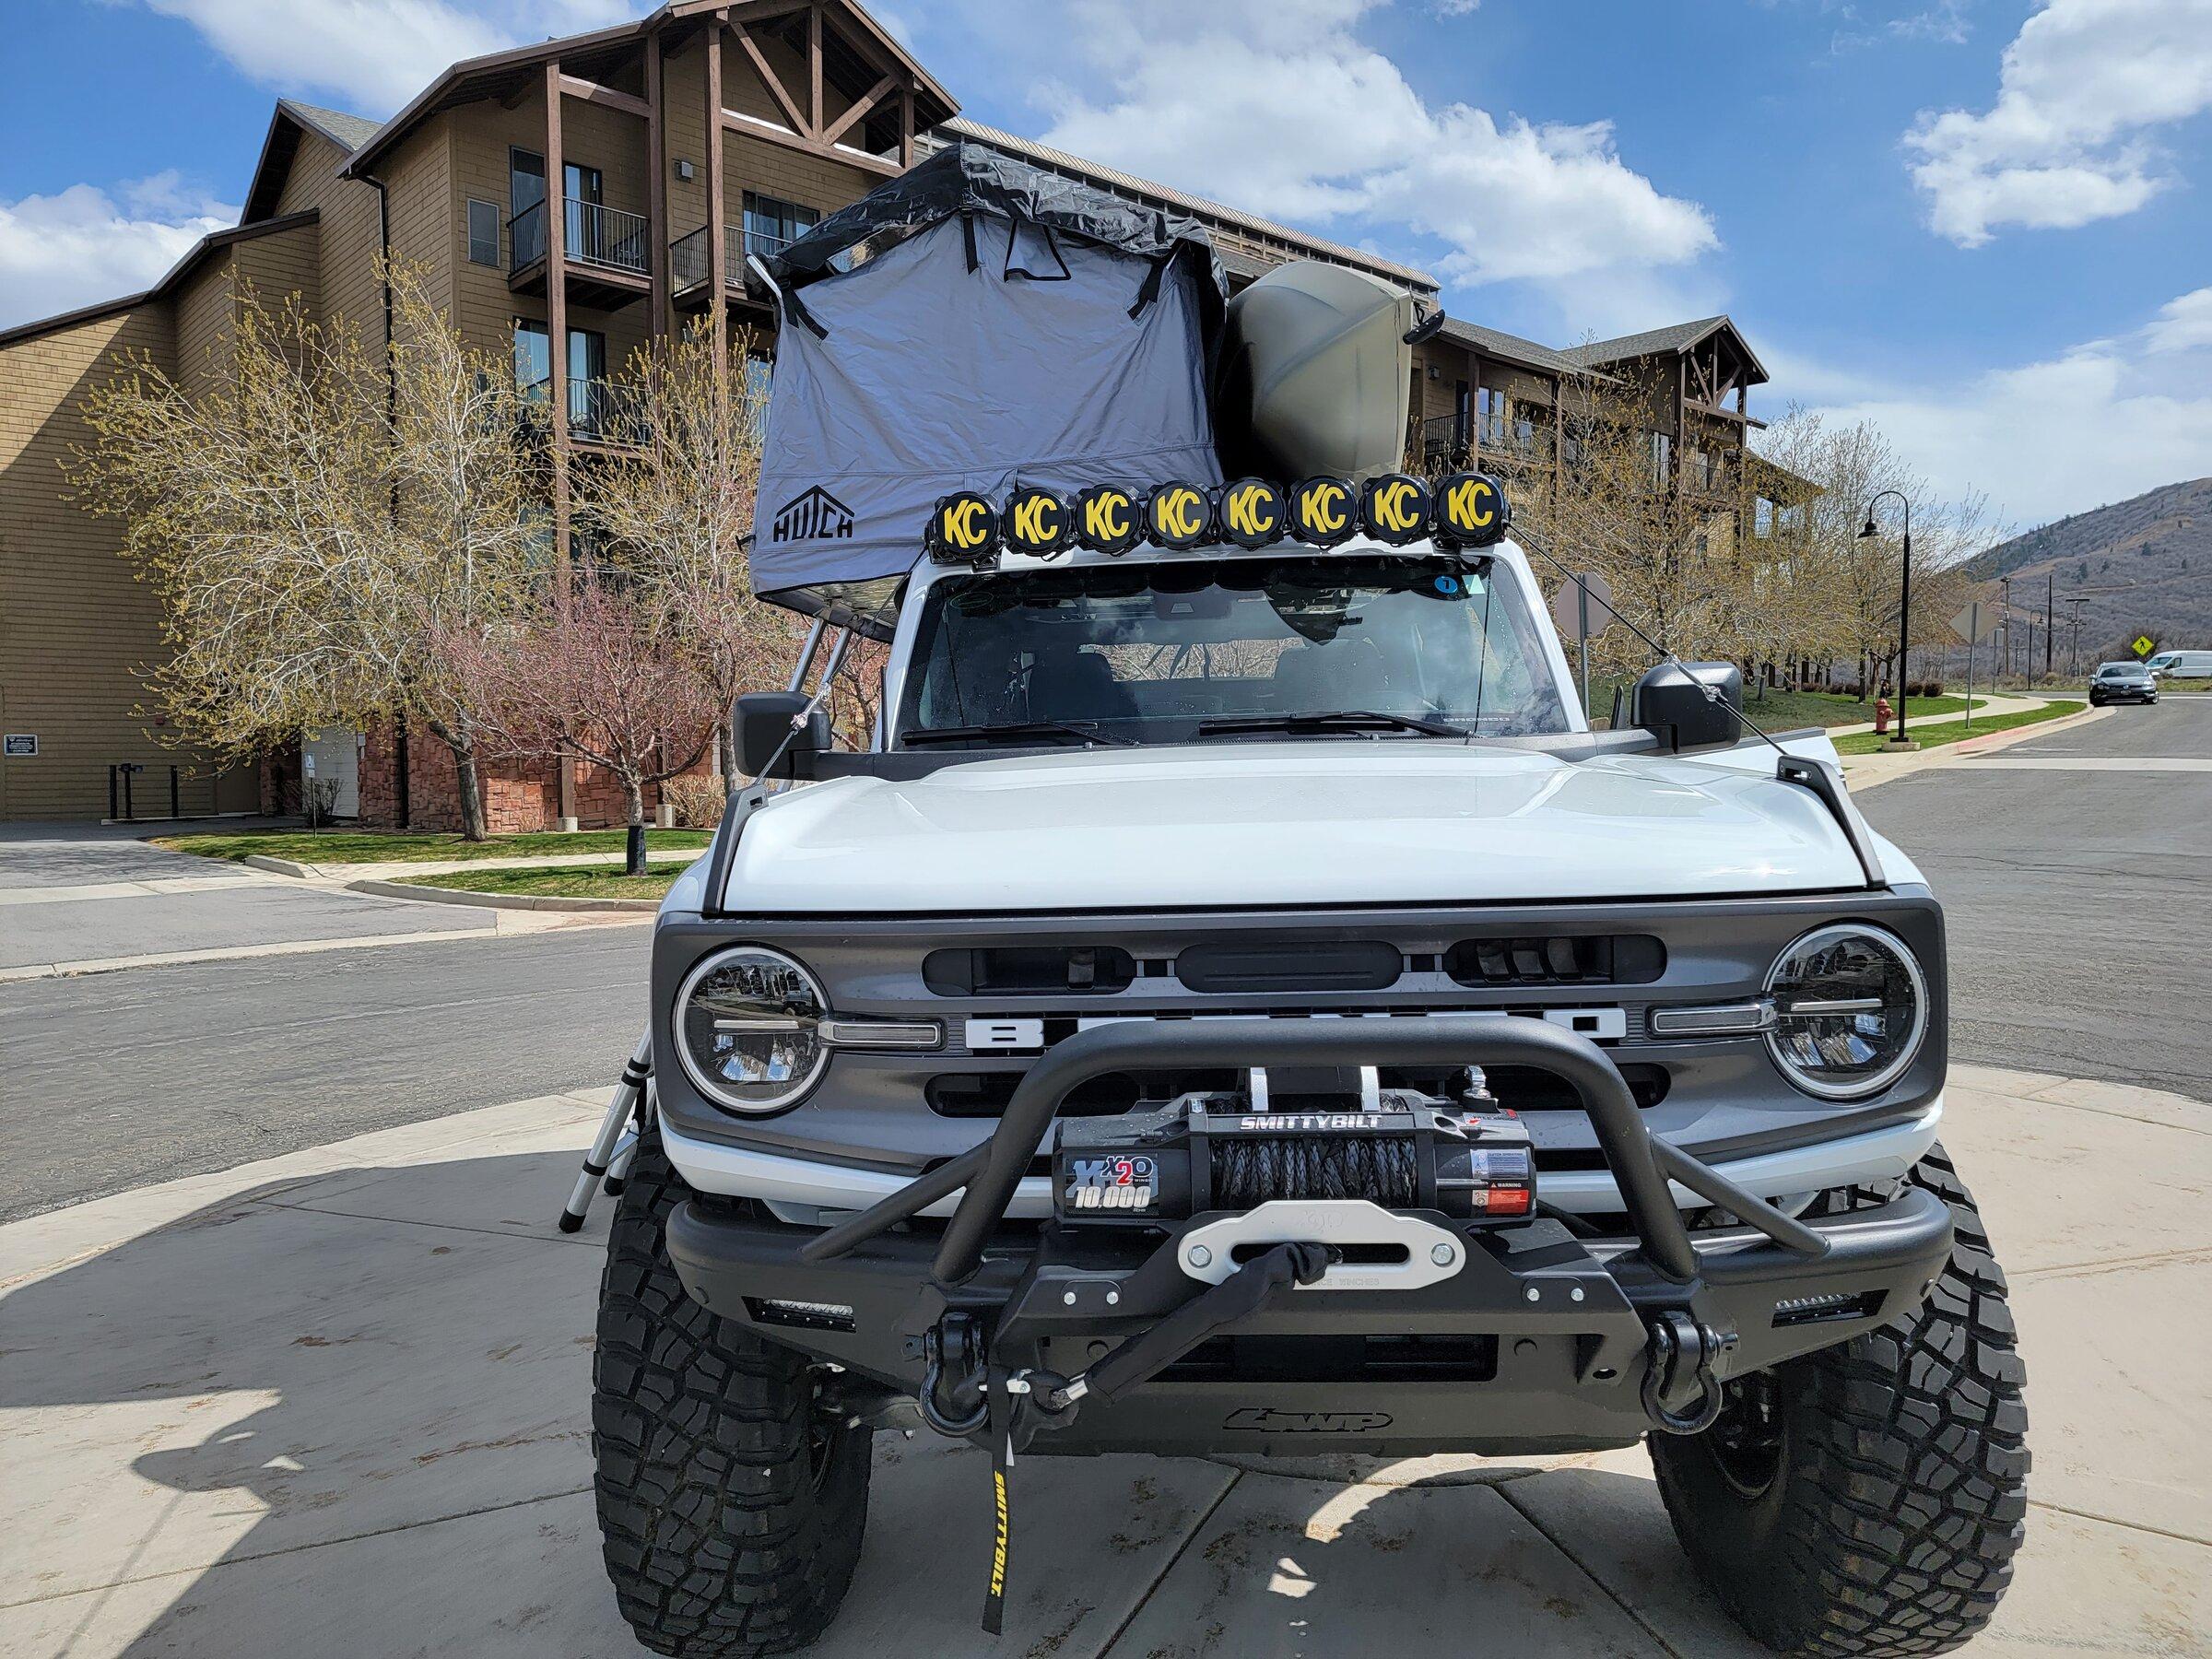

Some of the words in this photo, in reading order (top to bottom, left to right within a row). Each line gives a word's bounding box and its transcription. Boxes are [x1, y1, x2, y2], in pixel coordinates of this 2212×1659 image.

[773, 485, 854, 542] HUTCH
[944, 500, 987, 548] KC
[1015, 495, 1058, 545] KC
[1086, 491, 1129, 541] KC
[1158, 488, 1201, 538] KC
[1230, 486, 1273, 535] KC
[1301, 484, 1346, 533] KC
[1374, 481, 1419, 531] KC
[1448, 480, 1492, 530] KC
[1240, 1114, 1382, 1131] SMITTYBILT
[1075, 1185, 1152, 1209] 10,000
